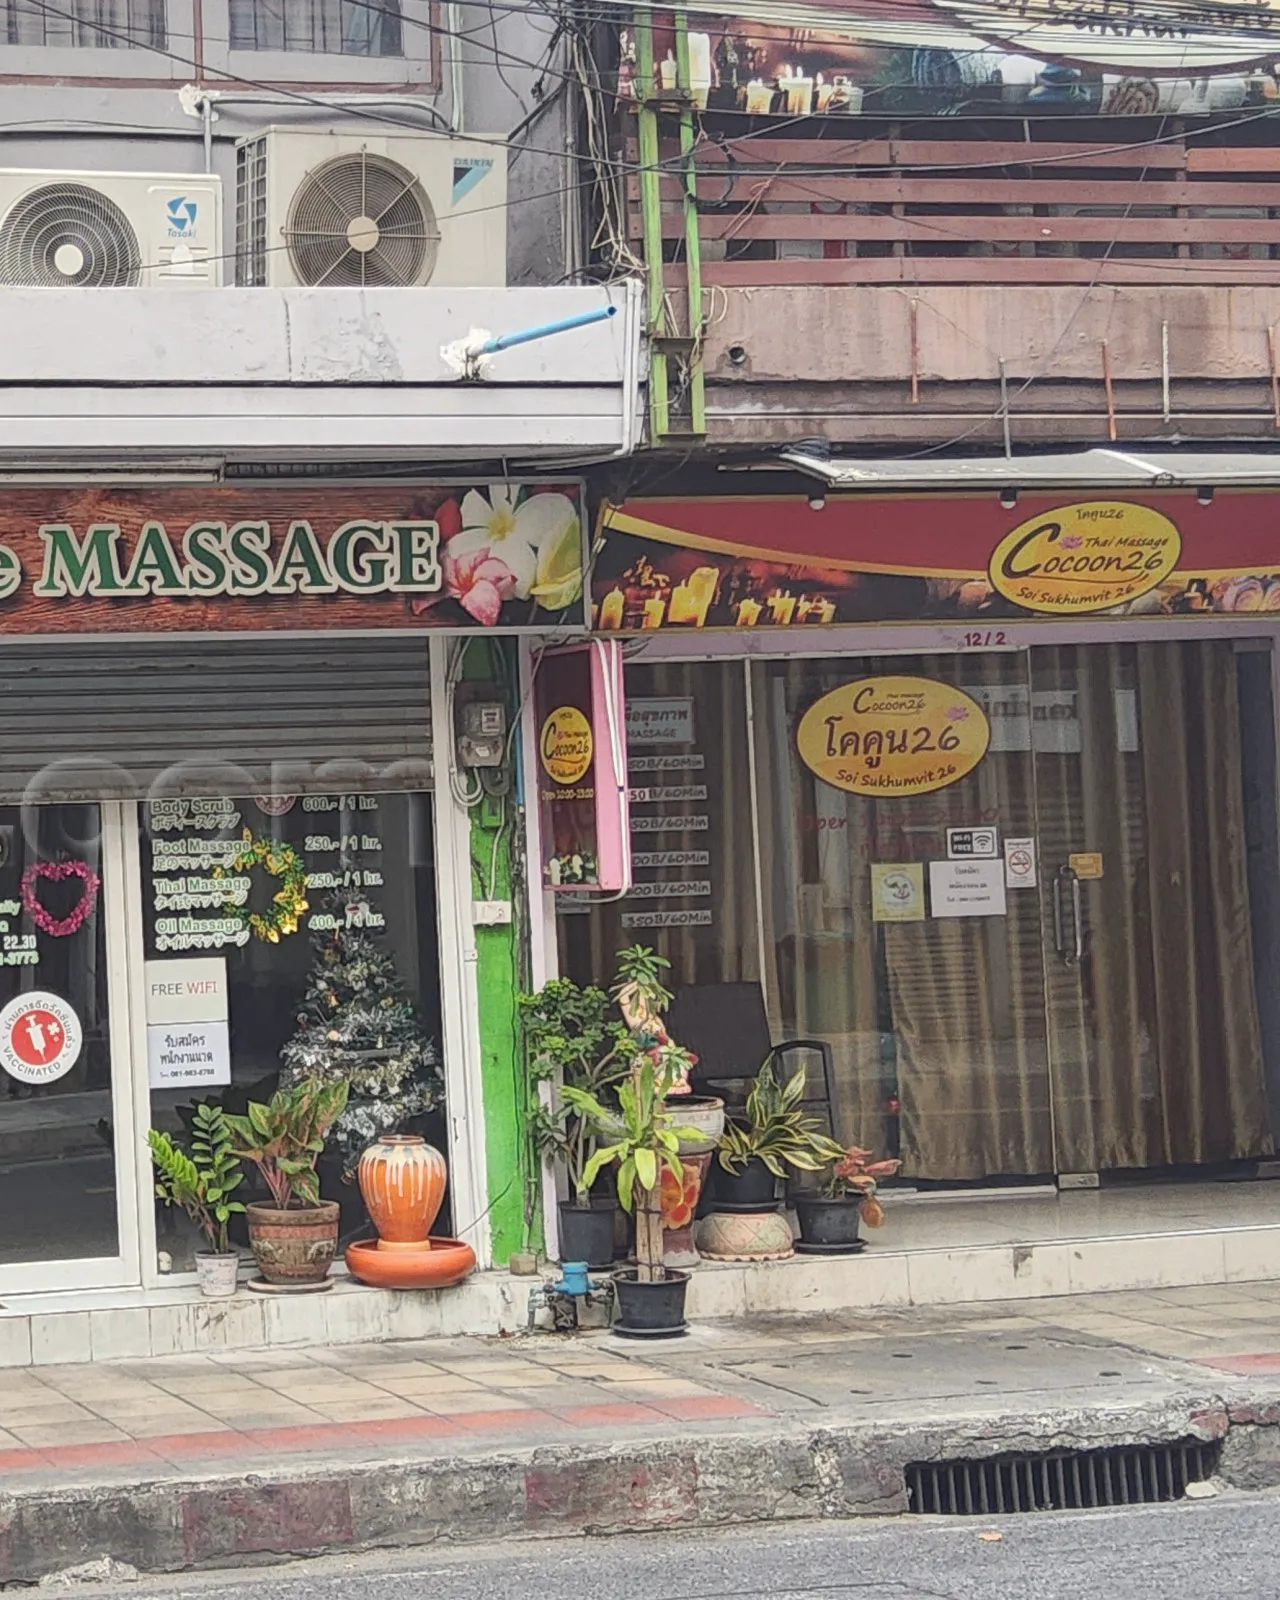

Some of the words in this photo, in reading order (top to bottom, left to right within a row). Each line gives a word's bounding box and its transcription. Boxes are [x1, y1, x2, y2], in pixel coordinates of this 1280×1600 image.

[1002, 523, 1162, 578] Cocoon26
[1085, 537, 1114, 548] Thai
[1116, 537, 1169, 550] Massage
[37, 523, 438, 593] MASSAGE
[1017, 586, 1038, 601] Soi
[1041, 591, 1112, 605] Sukhumvit
[1115, 584, 1135, 598] 26
[853, 687, 926, 714] Cocoon26
[544, 722, 590, 760] Cocoon26
[824, 716, 960, 769] โคคูน26
[836, 769, 858, 784] Soi
[861, 772, 935, 788] Sukhumvit
[937, 764, 956, 781] 26
[152, 801, 188, 815] Body
[191, 799, 234, 813] Scrub
[153, 839, 187, 854] Foot
[188, 838, 251, 855] Massage
[154, 878, 186, 894] Thai
[188, 877, 251, 893] Massage
[155, 917, 177, 934] Oil
[179, 916, 242, 933] Massage
[3, 935, 37, 950] 22.30
[151, 984, 183, 997] FREE
[186, 981, 217, 995] WIFI
[164, 1033, 206, 1048] รับสมัคร
[4, 1046, 61, 1077] VACCINATED
[159, 1050, 214, 1065] พนักงานนวด
